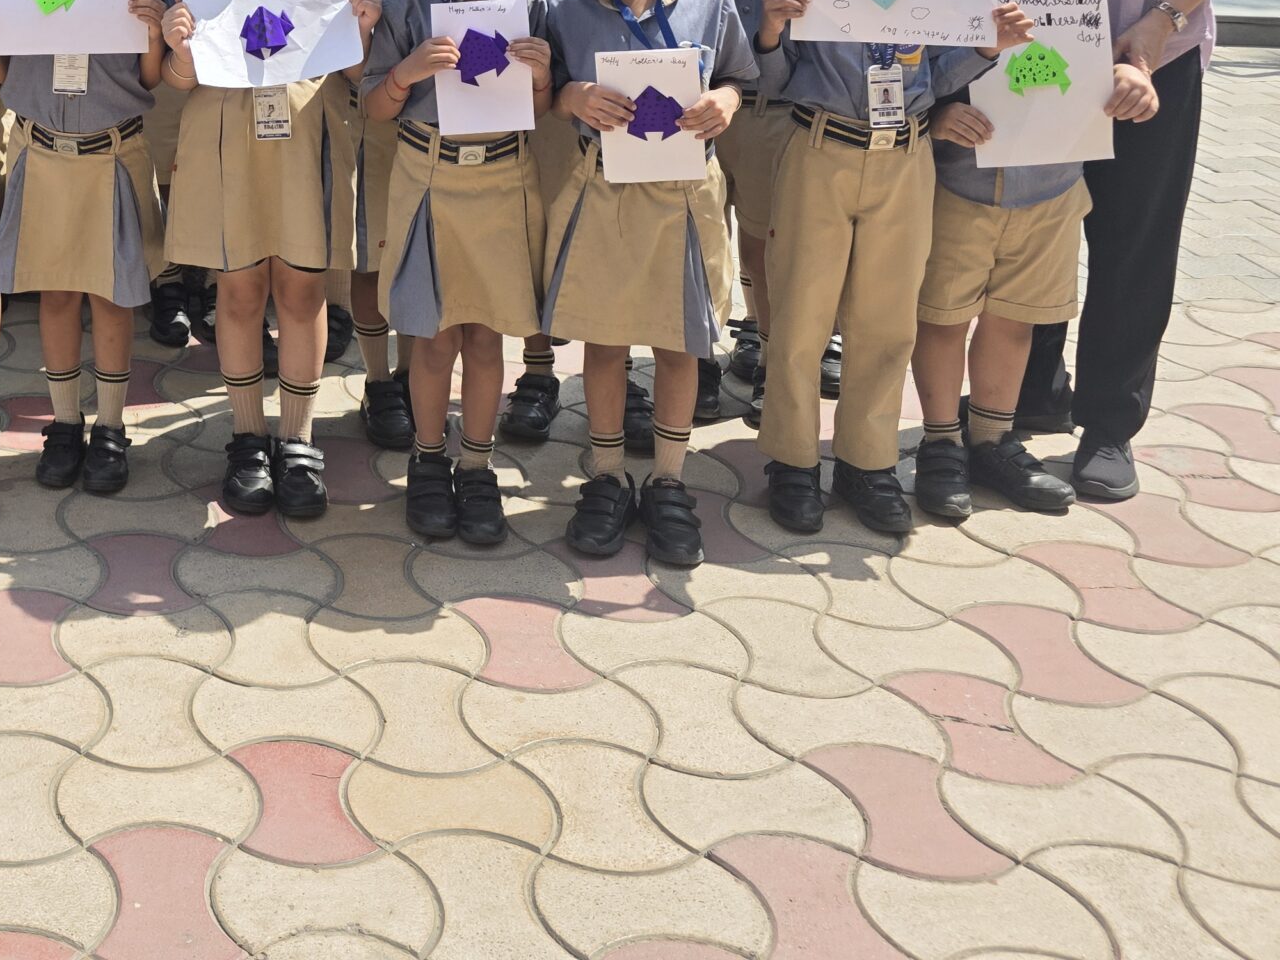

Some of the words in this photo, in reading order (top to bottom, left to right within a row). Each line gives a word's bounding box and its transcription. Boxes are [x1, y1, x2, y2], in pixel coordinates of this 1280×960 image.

[1033, 13, 1078, 27] others
[880, 25, 898, 35] Day
[1077, 32, 1105, 48] day
